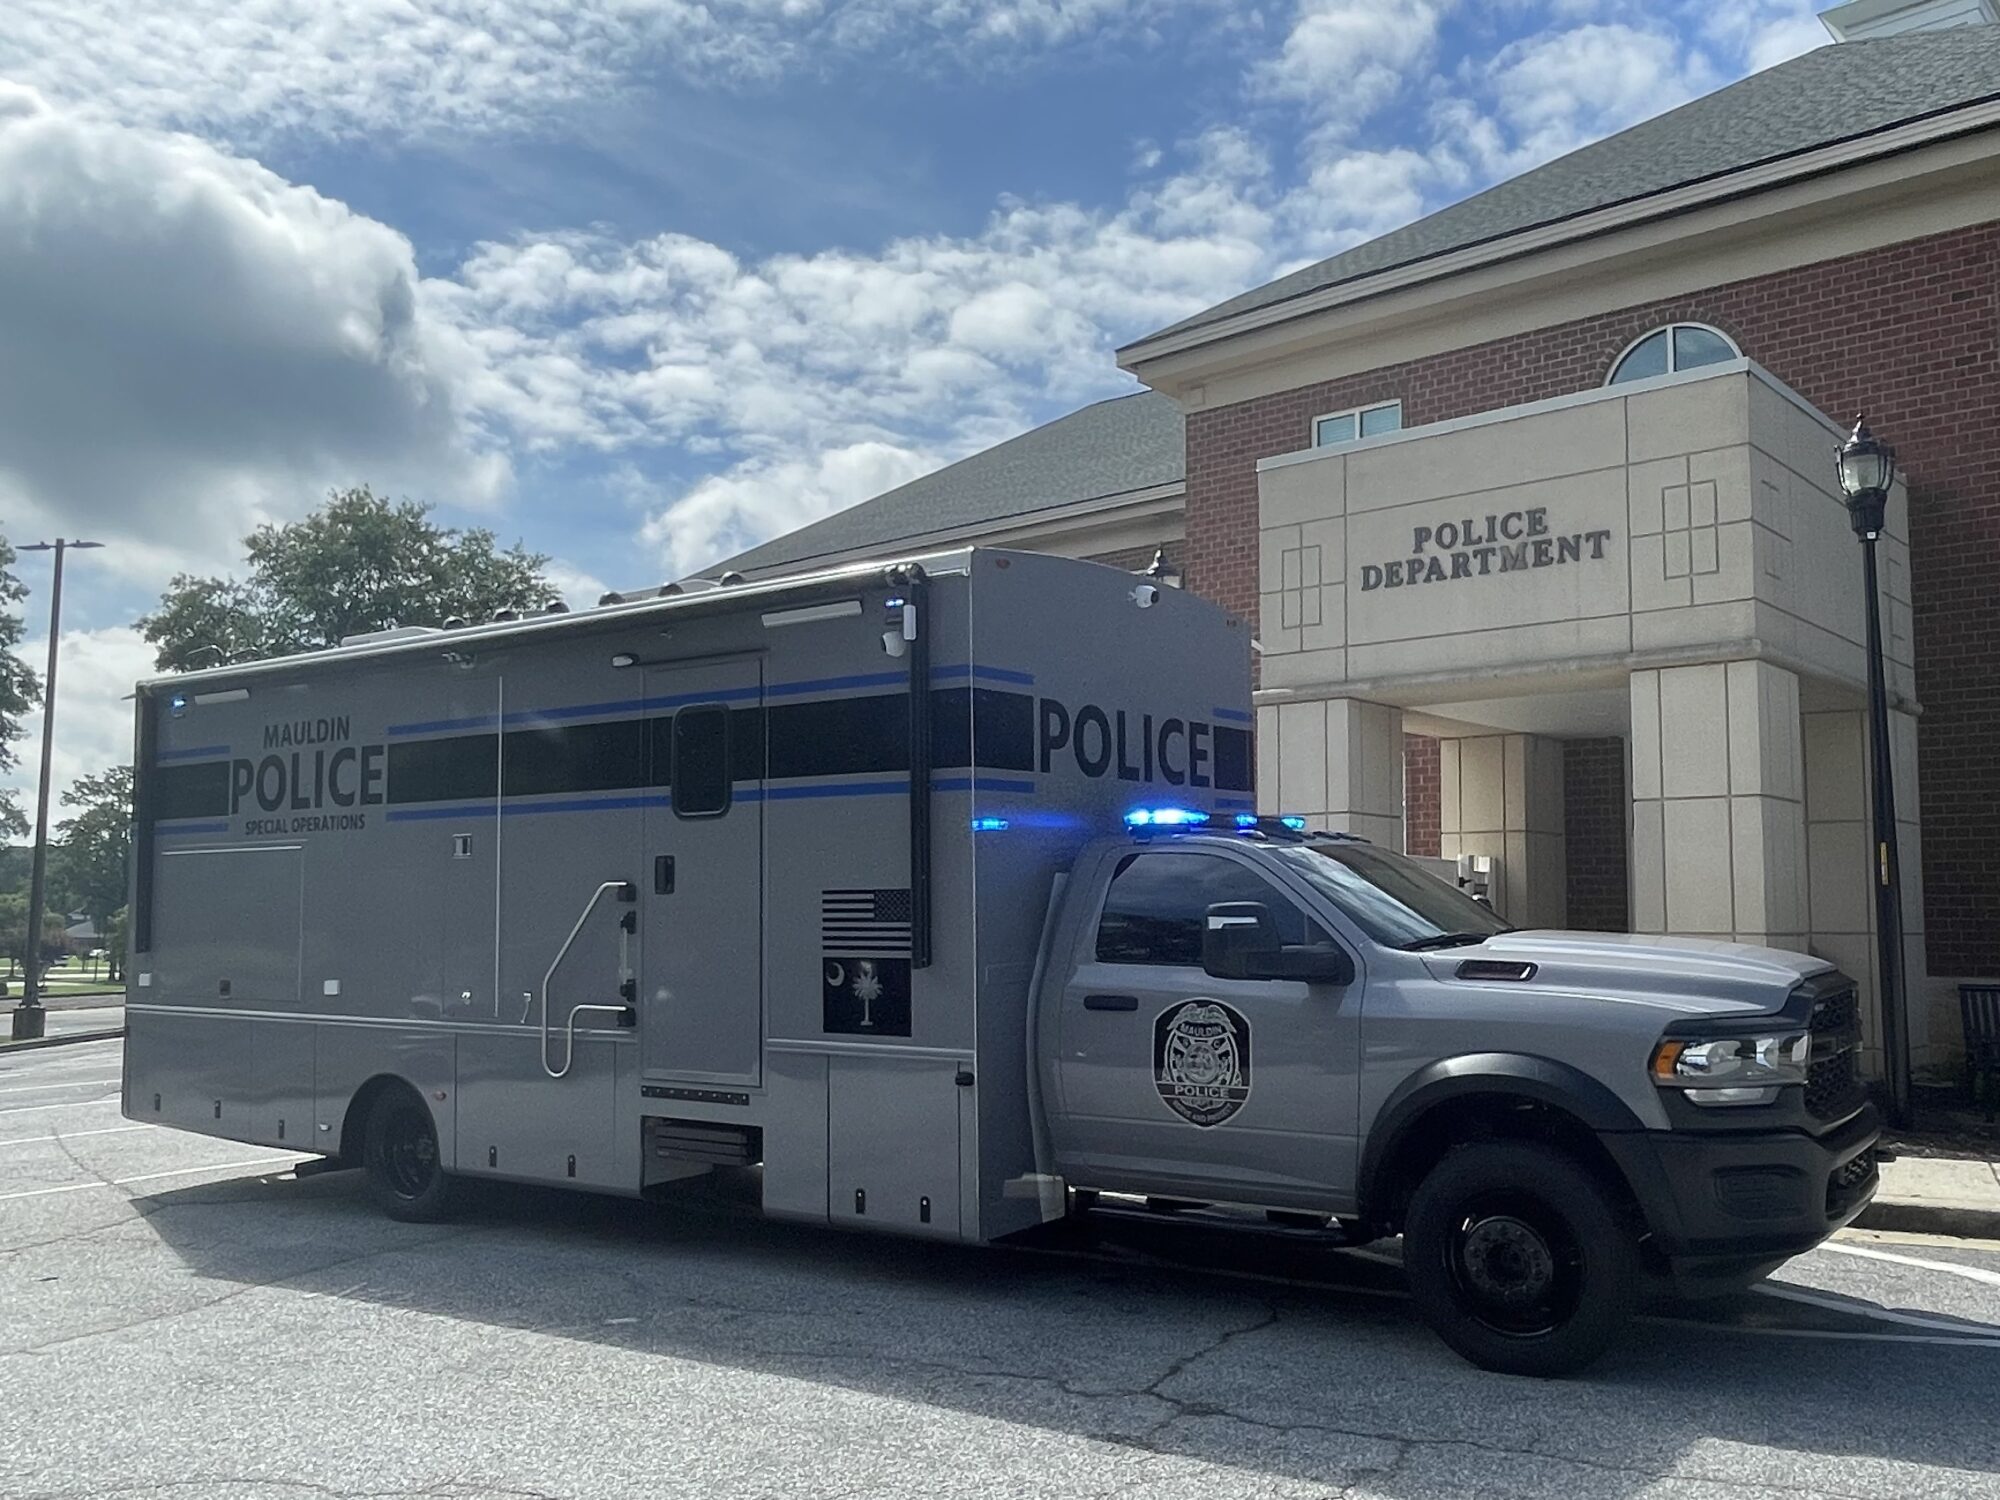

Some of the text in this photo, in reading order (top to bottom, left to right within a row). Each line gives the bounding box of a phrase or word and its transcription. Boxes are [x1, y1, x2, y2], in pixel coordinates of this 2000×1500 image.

[1412, 507, 1548, 554] POLICE
[1360, 530, 1610, 591] DEPARTMENT
[263, 716, 350, 749] MAULDIN
[1039, 697, 1211, 787] POLICE
[231, 745, 385, 815] POLICE
[245, 814, 366, 836] SPECIAL OPERATIONS
[1180, 1023, 1222, 1037] MAULDIN
[1174, 1085, 1230, 1098] POLICE
